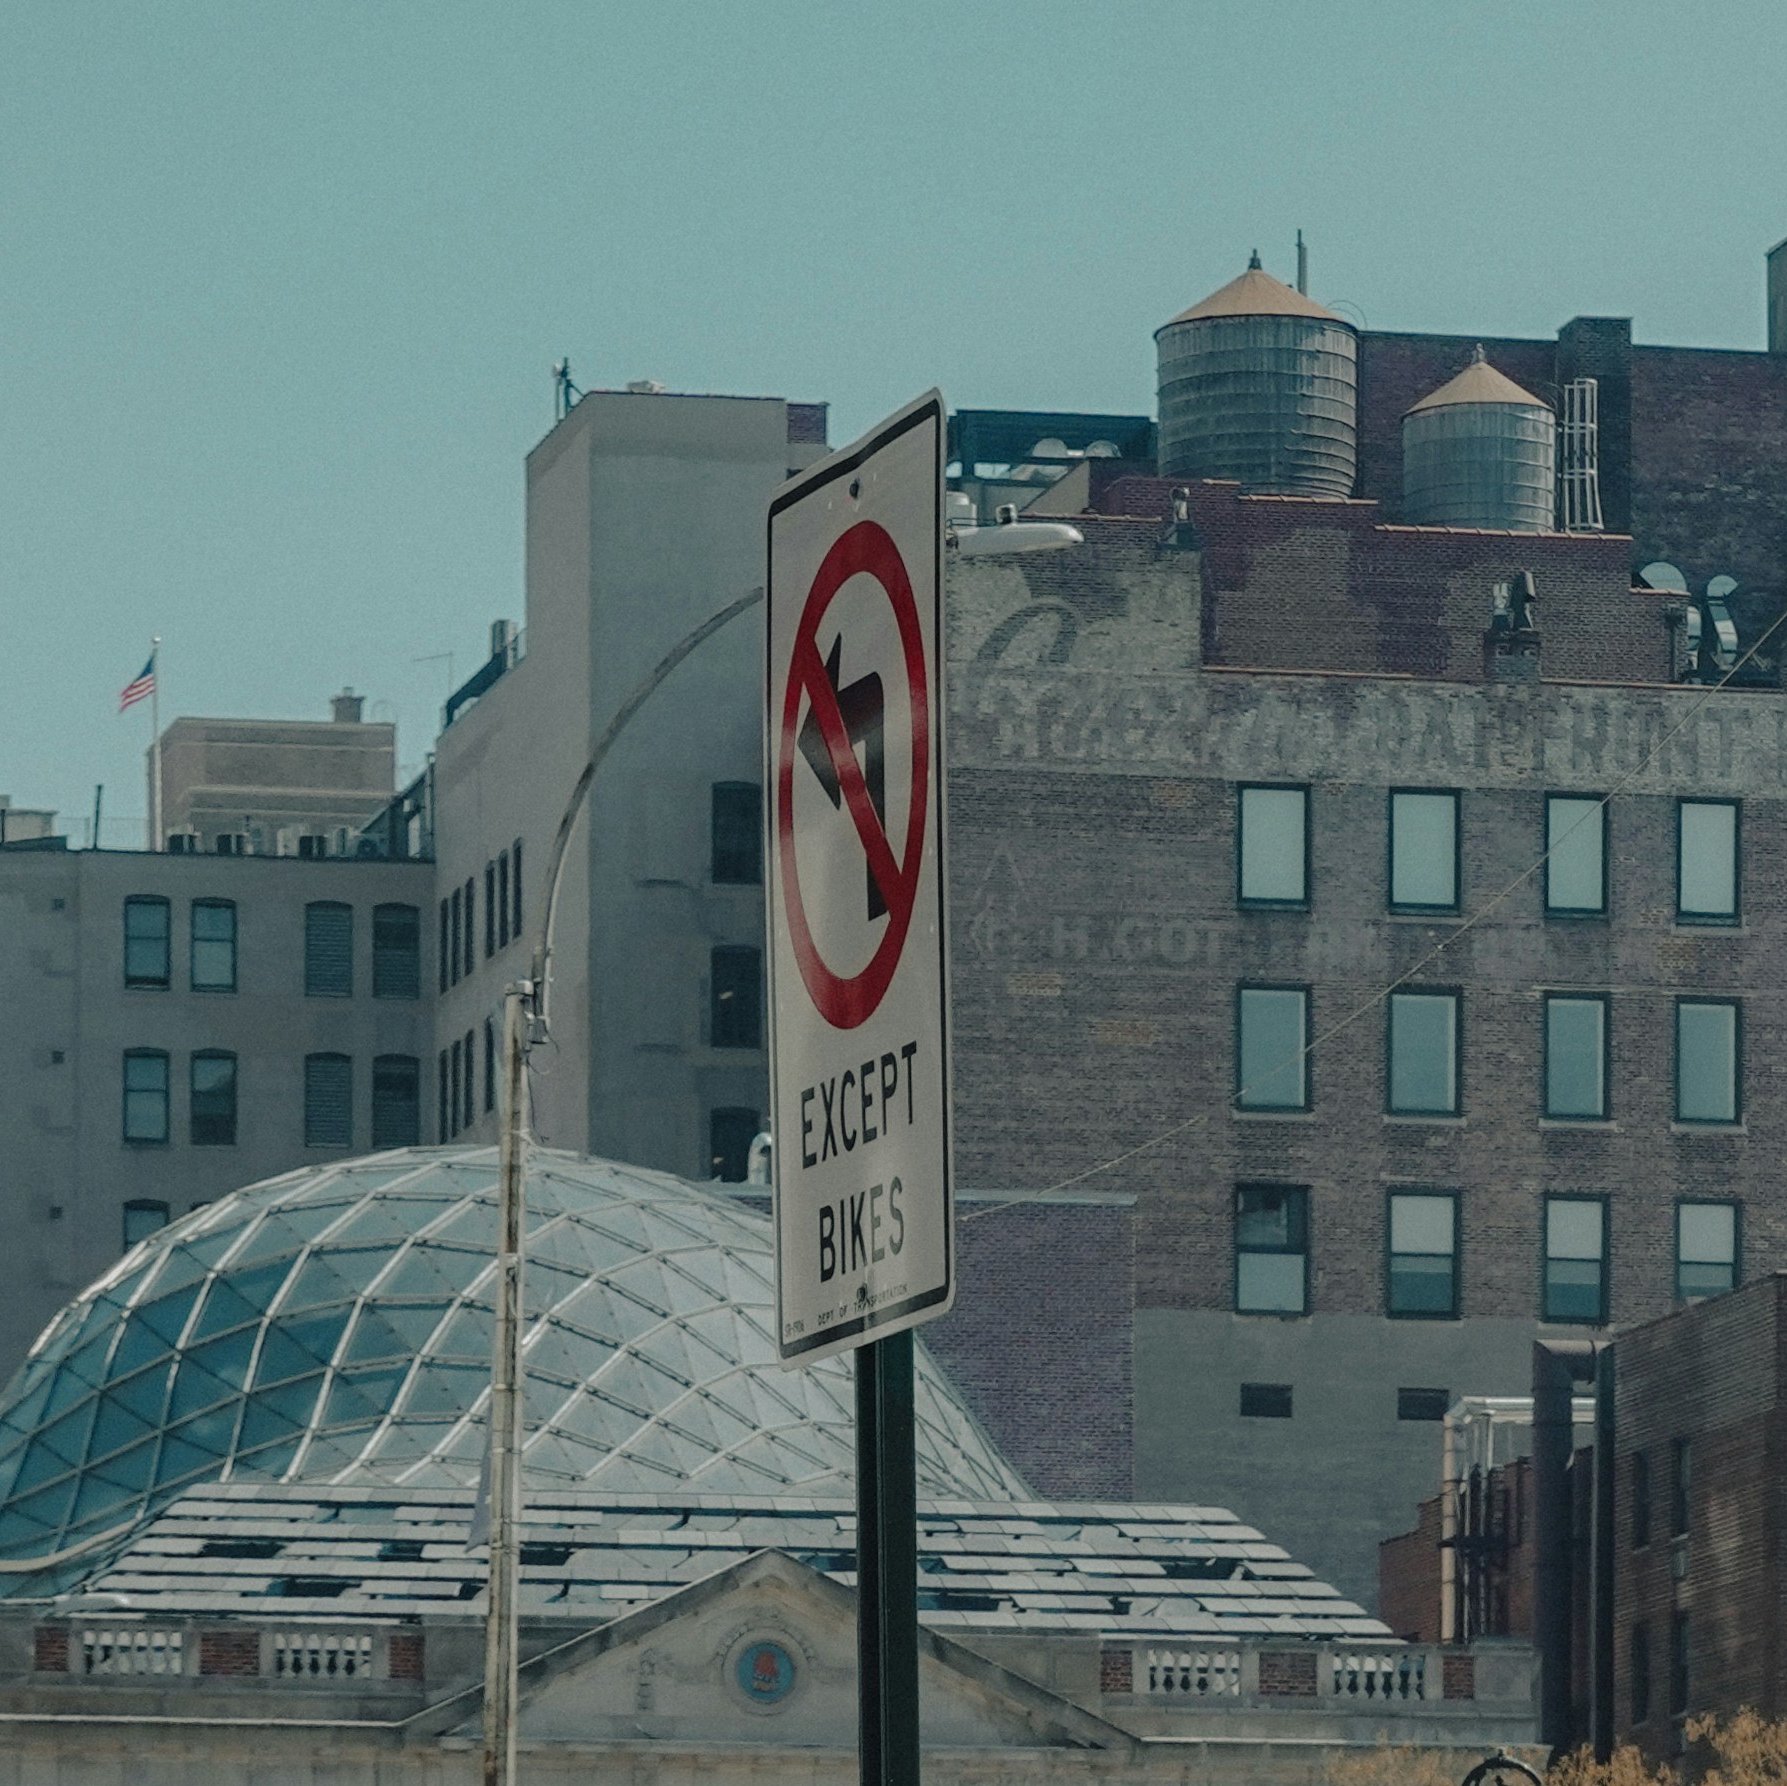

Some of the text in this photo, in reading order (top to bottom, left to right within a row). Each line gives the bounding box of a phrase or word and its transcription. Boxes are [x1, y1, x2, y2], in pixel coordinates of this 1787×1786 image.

[801, 1040, 917, 1170] EXCEPT
[819, 1175, 905, 1283] BIKES
[817, 1310, 834, 1326] DEPT
[839, 1305, 848, 1317] OF
